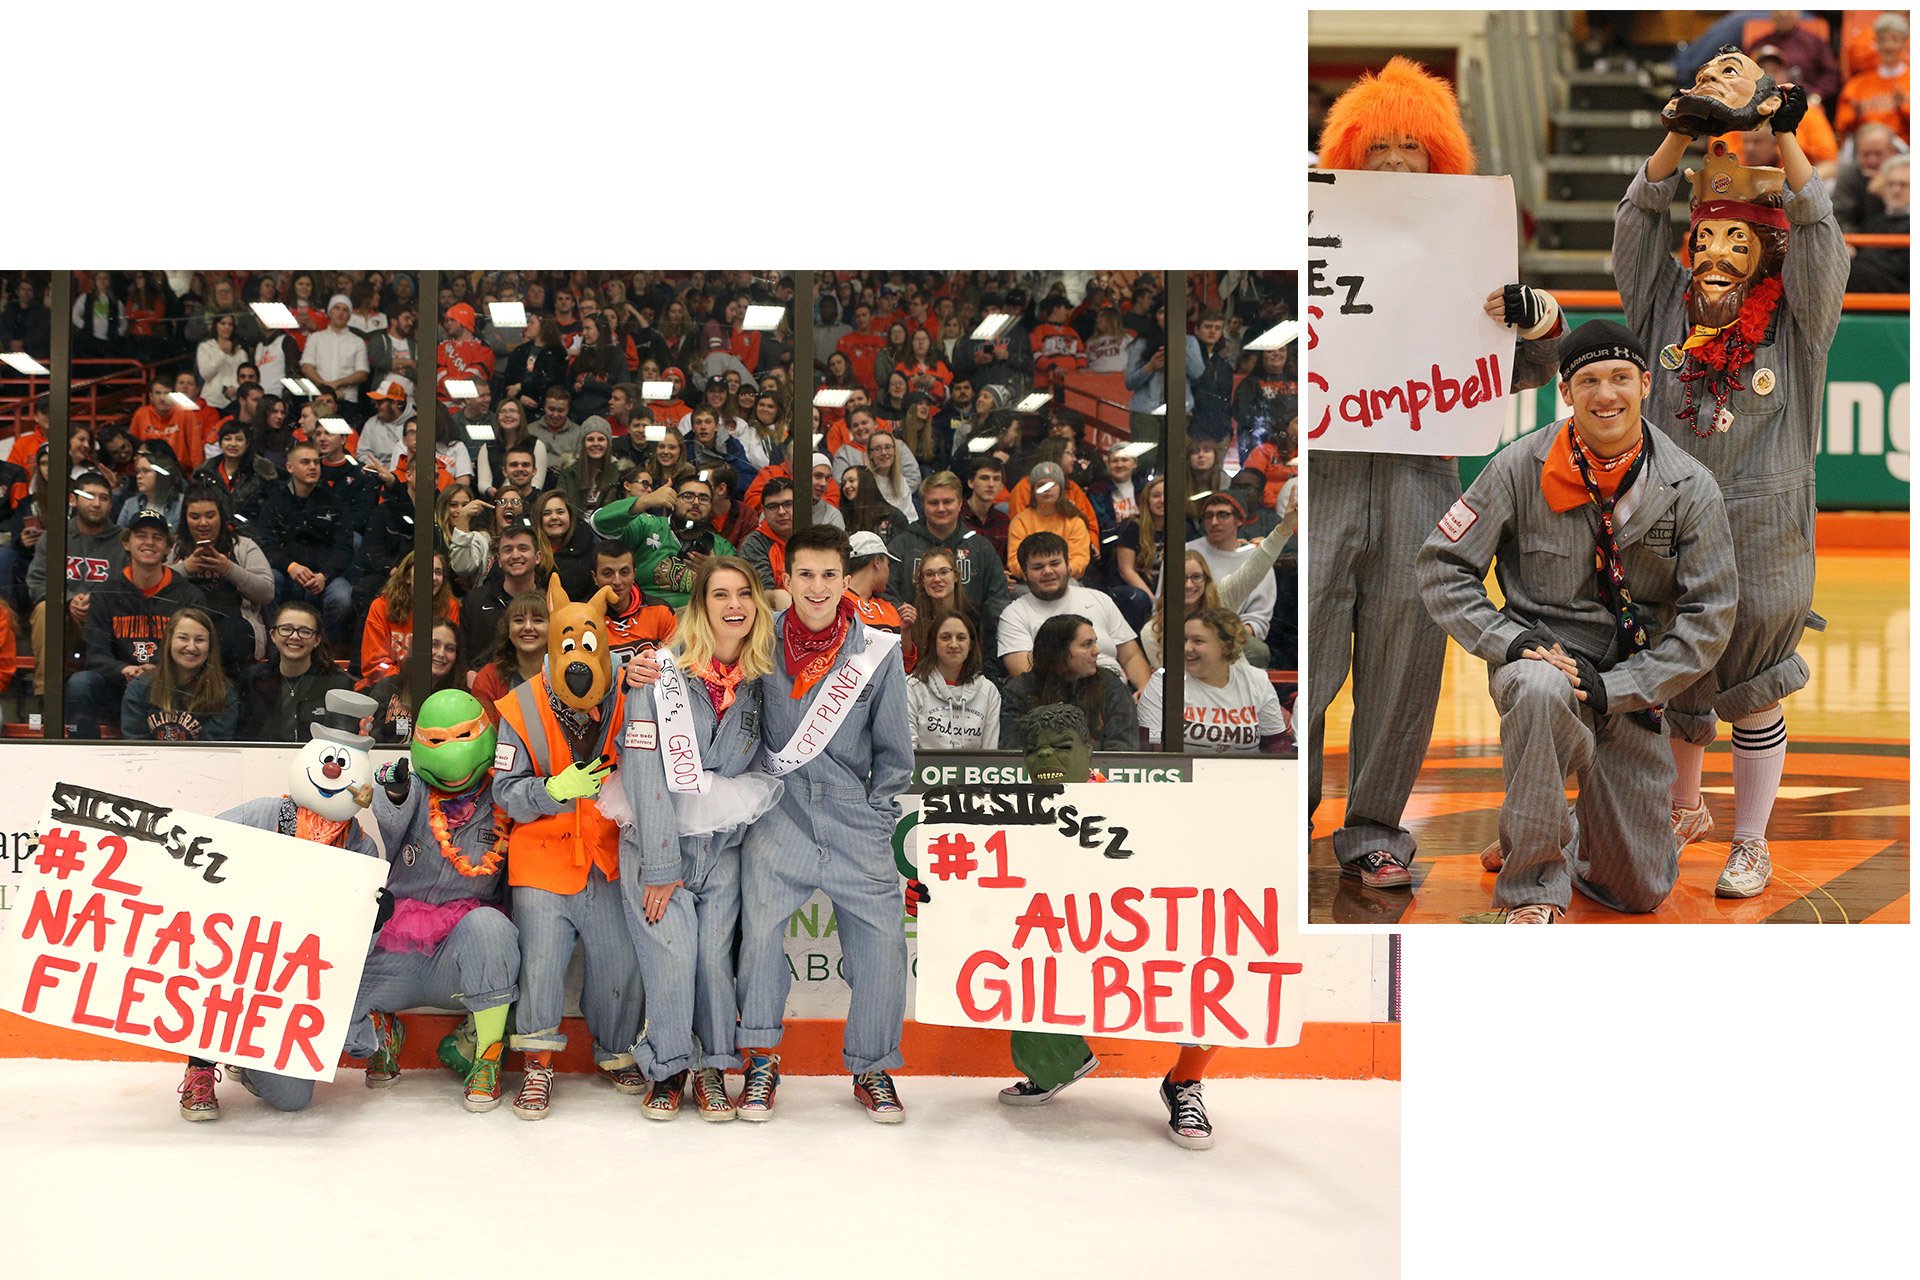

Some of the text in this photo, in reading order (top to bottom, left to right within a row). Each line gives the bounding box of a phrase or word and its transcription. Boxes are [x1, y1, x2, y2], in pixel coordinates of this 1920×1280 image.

[1570, 349, 1610, 371] ARMOUR
[816, 658, 863, 723] PLANET
[668, 734, 701, 793] GROOT
[921, 766, 957, 785] OF
[964, 766, 1033, 785] BGSU
[34, 827, 143, 895] #2
[927, 830, 1027, 889] #1
[1058, 805, 1136, 859] SEZ
[21, 888, 333, 1000] NATASHA
[1012, 887, 1279, 956] AUSTIN
[21, 954, 325, 1072] FLESHER
[955, 950, 1303, 1046] GILBERT
